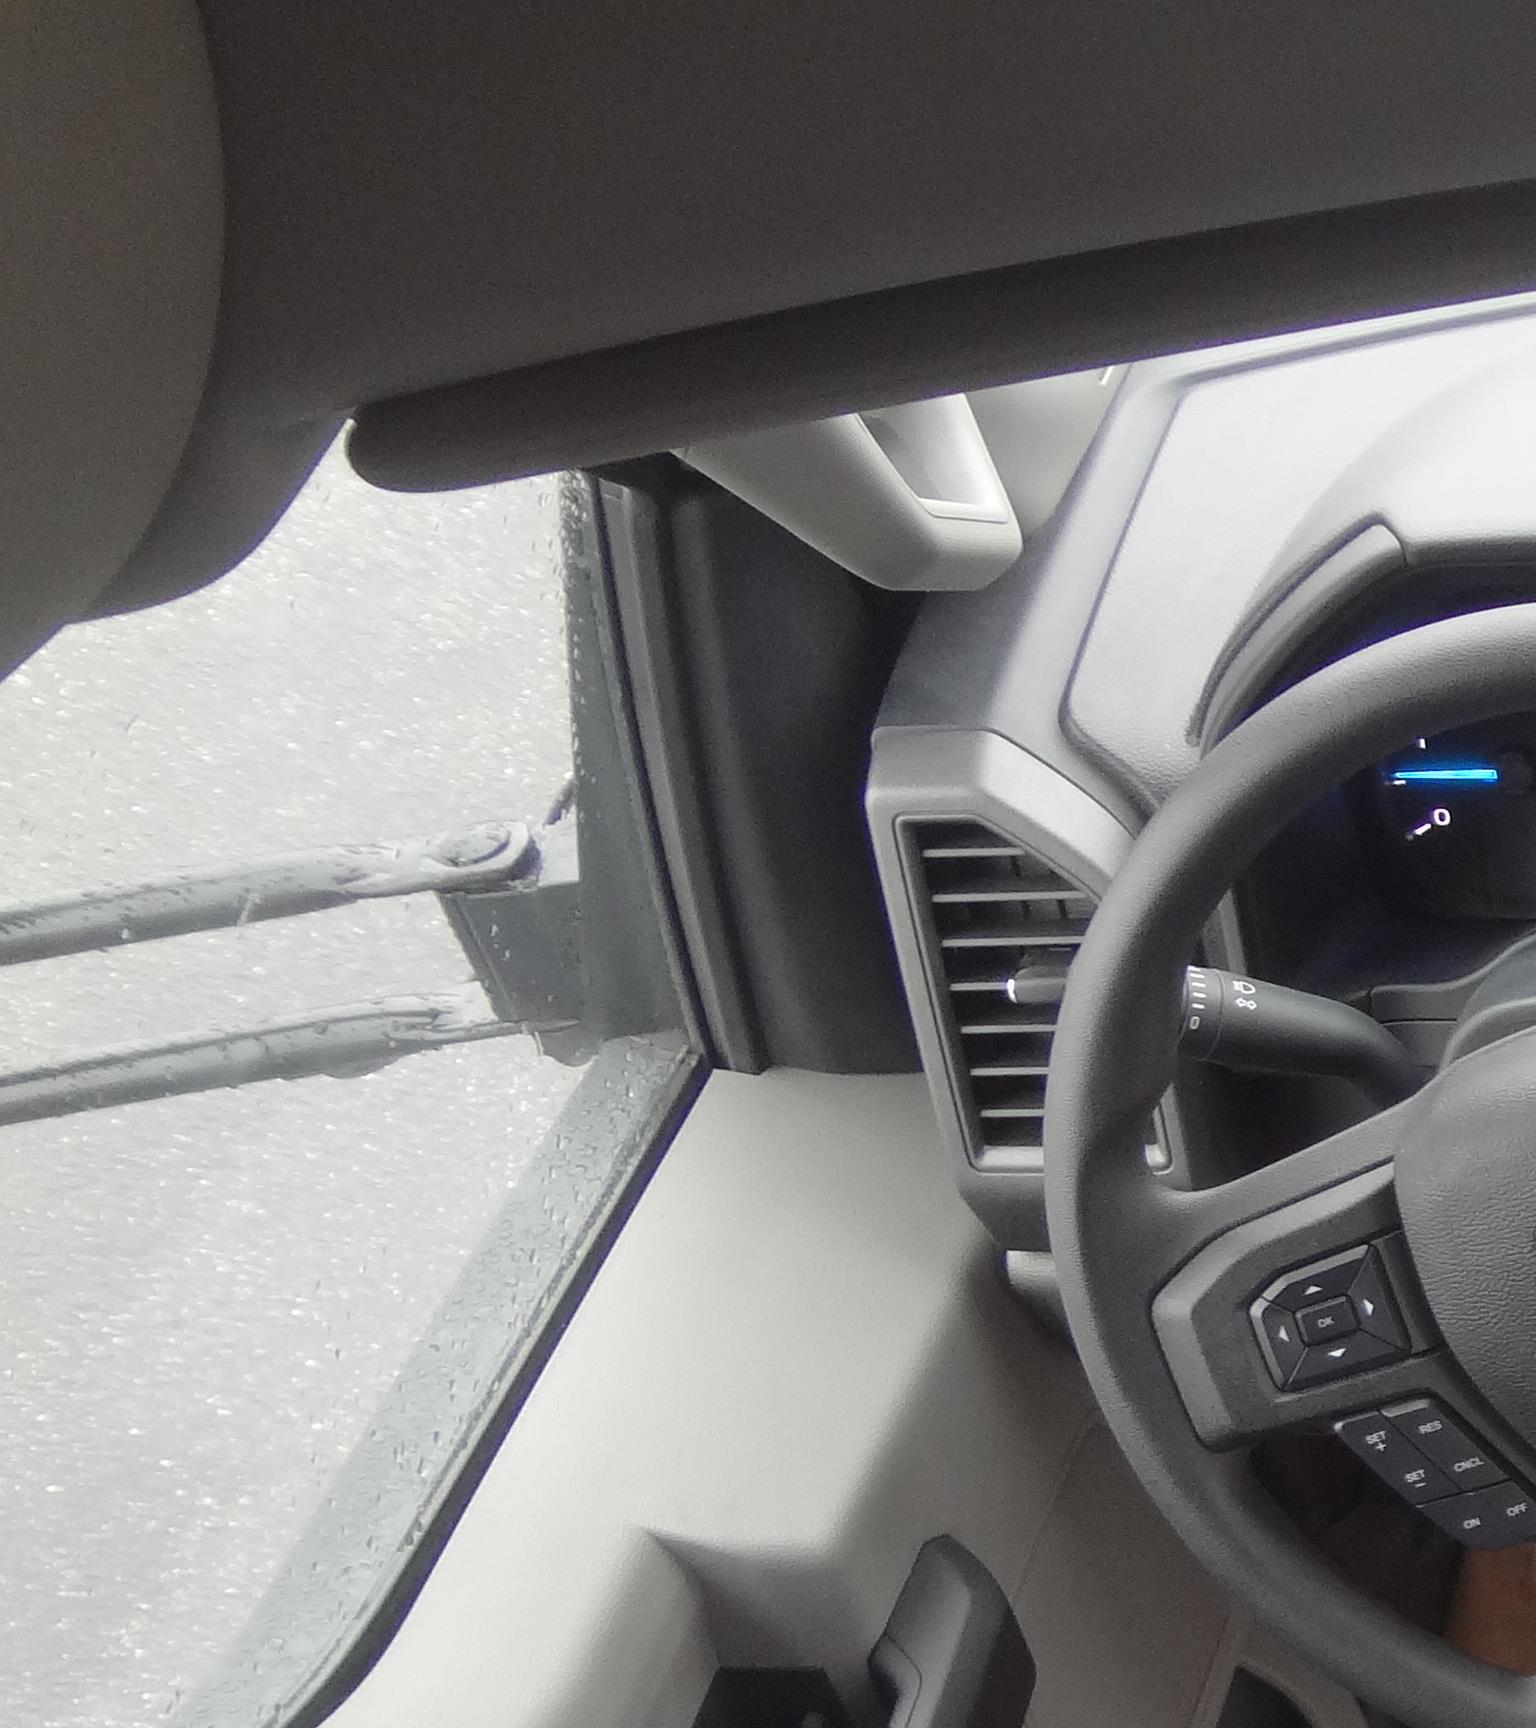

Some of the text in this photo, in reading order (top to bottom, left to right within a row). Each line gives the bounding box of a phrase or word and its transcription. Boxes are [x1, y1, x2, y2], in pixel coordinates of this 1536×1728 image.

[1433, 809, 1451, 826] 0
[1317, 1315, 1335, 1329] OK
[1419, 1420, 1443, 1435] RES
[1365, 1430, 1387, 1445] SET
[1453, 1456, 1485, 1472] CNCL
[1405, 1469, 1425, 1483] SET
[1506, 1502, 1528, 1517] OFF
[1463, 1517, 1481, 1529] ON
